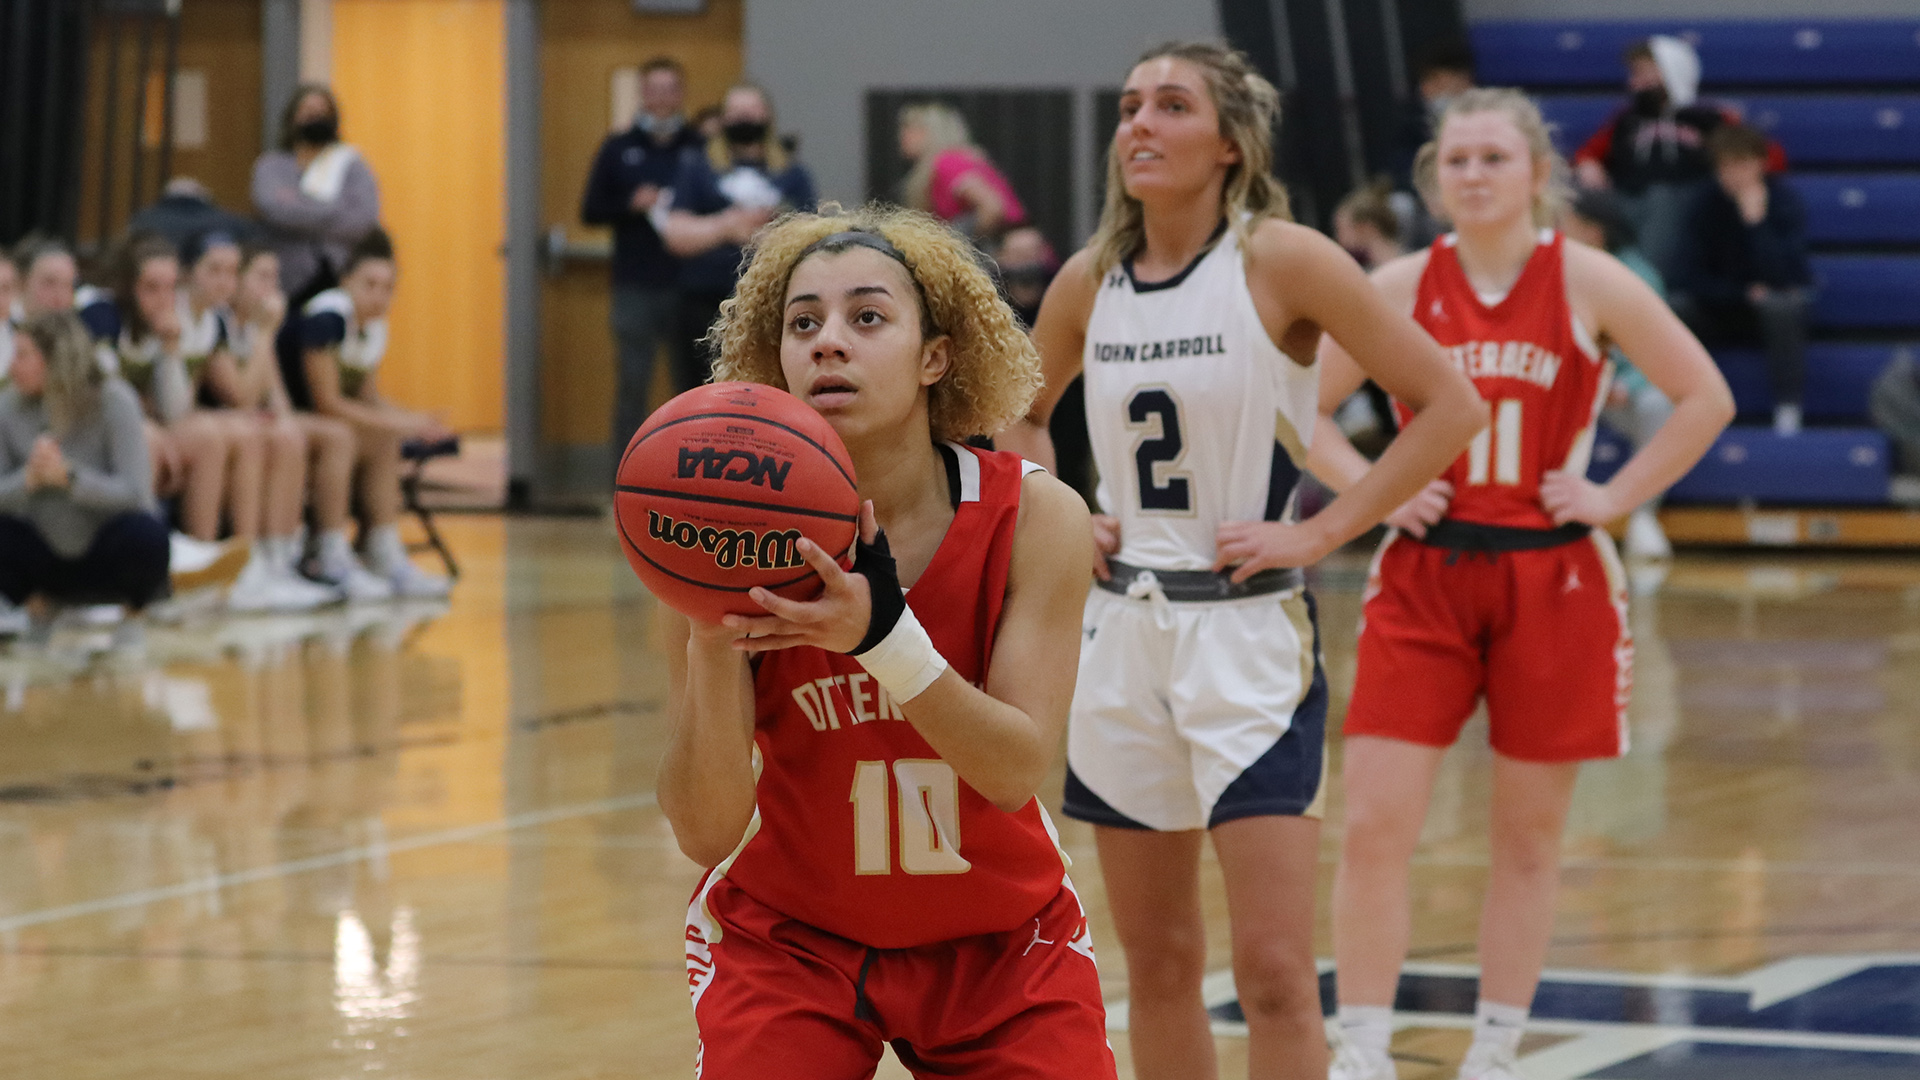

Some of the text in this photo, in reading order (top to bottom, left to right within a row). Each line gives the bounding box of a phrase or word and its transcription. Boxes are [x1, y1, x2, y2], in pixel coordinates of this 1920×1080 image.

[1140, 334, 1226, 361] CARROLL
[678, 446, 793, 492] NCAA
[1122, 381, 1197, 518] 2
[1466, 398, 1522, 486] 11
[648, 510, 806, 569] Wilson
[849, 758, 972, 875] 10
